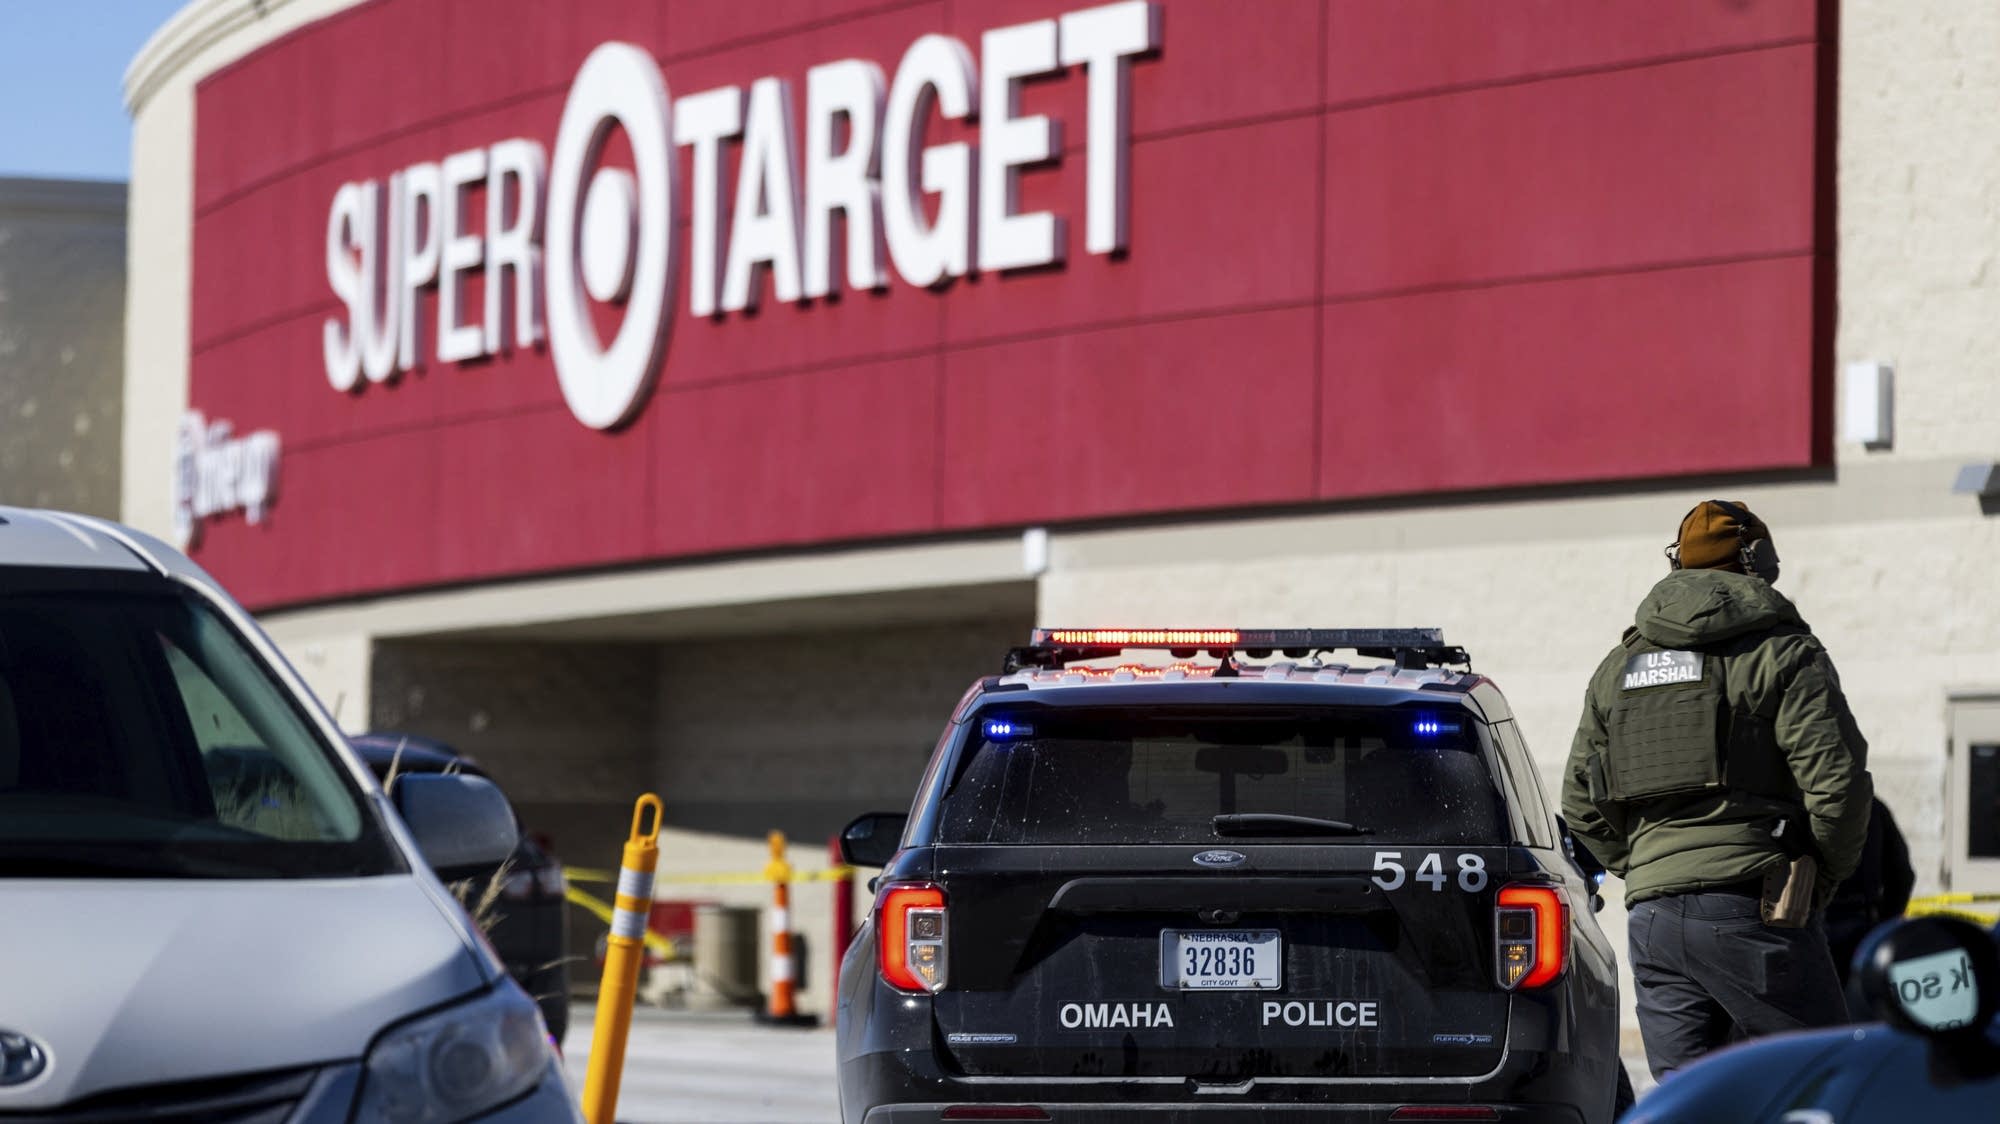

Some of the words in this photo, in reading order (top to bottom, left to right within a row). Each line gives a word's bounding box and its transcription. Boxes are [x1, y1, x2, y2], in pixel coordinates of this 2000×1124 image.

[323, 138, 546, 392] SUPER
[674, 0, 1162, 320] TARGET
[1646, 651, 1676, 669] U.S.
[1624, 664, 1698, 689] MARSHAL
[1371, 851, 1488, 893] 548
[1191, 933, 1249, 943] NEBRASKA
[1185, 946, 1255, 977] 32836
[1200, 979, 1218, 987] CITY
[1218, 979, 1239, 987] GOVT
[1059, 1003, 1174, 1029] OMAHA
[1262, 1002, 1378, 1027] POLICE
